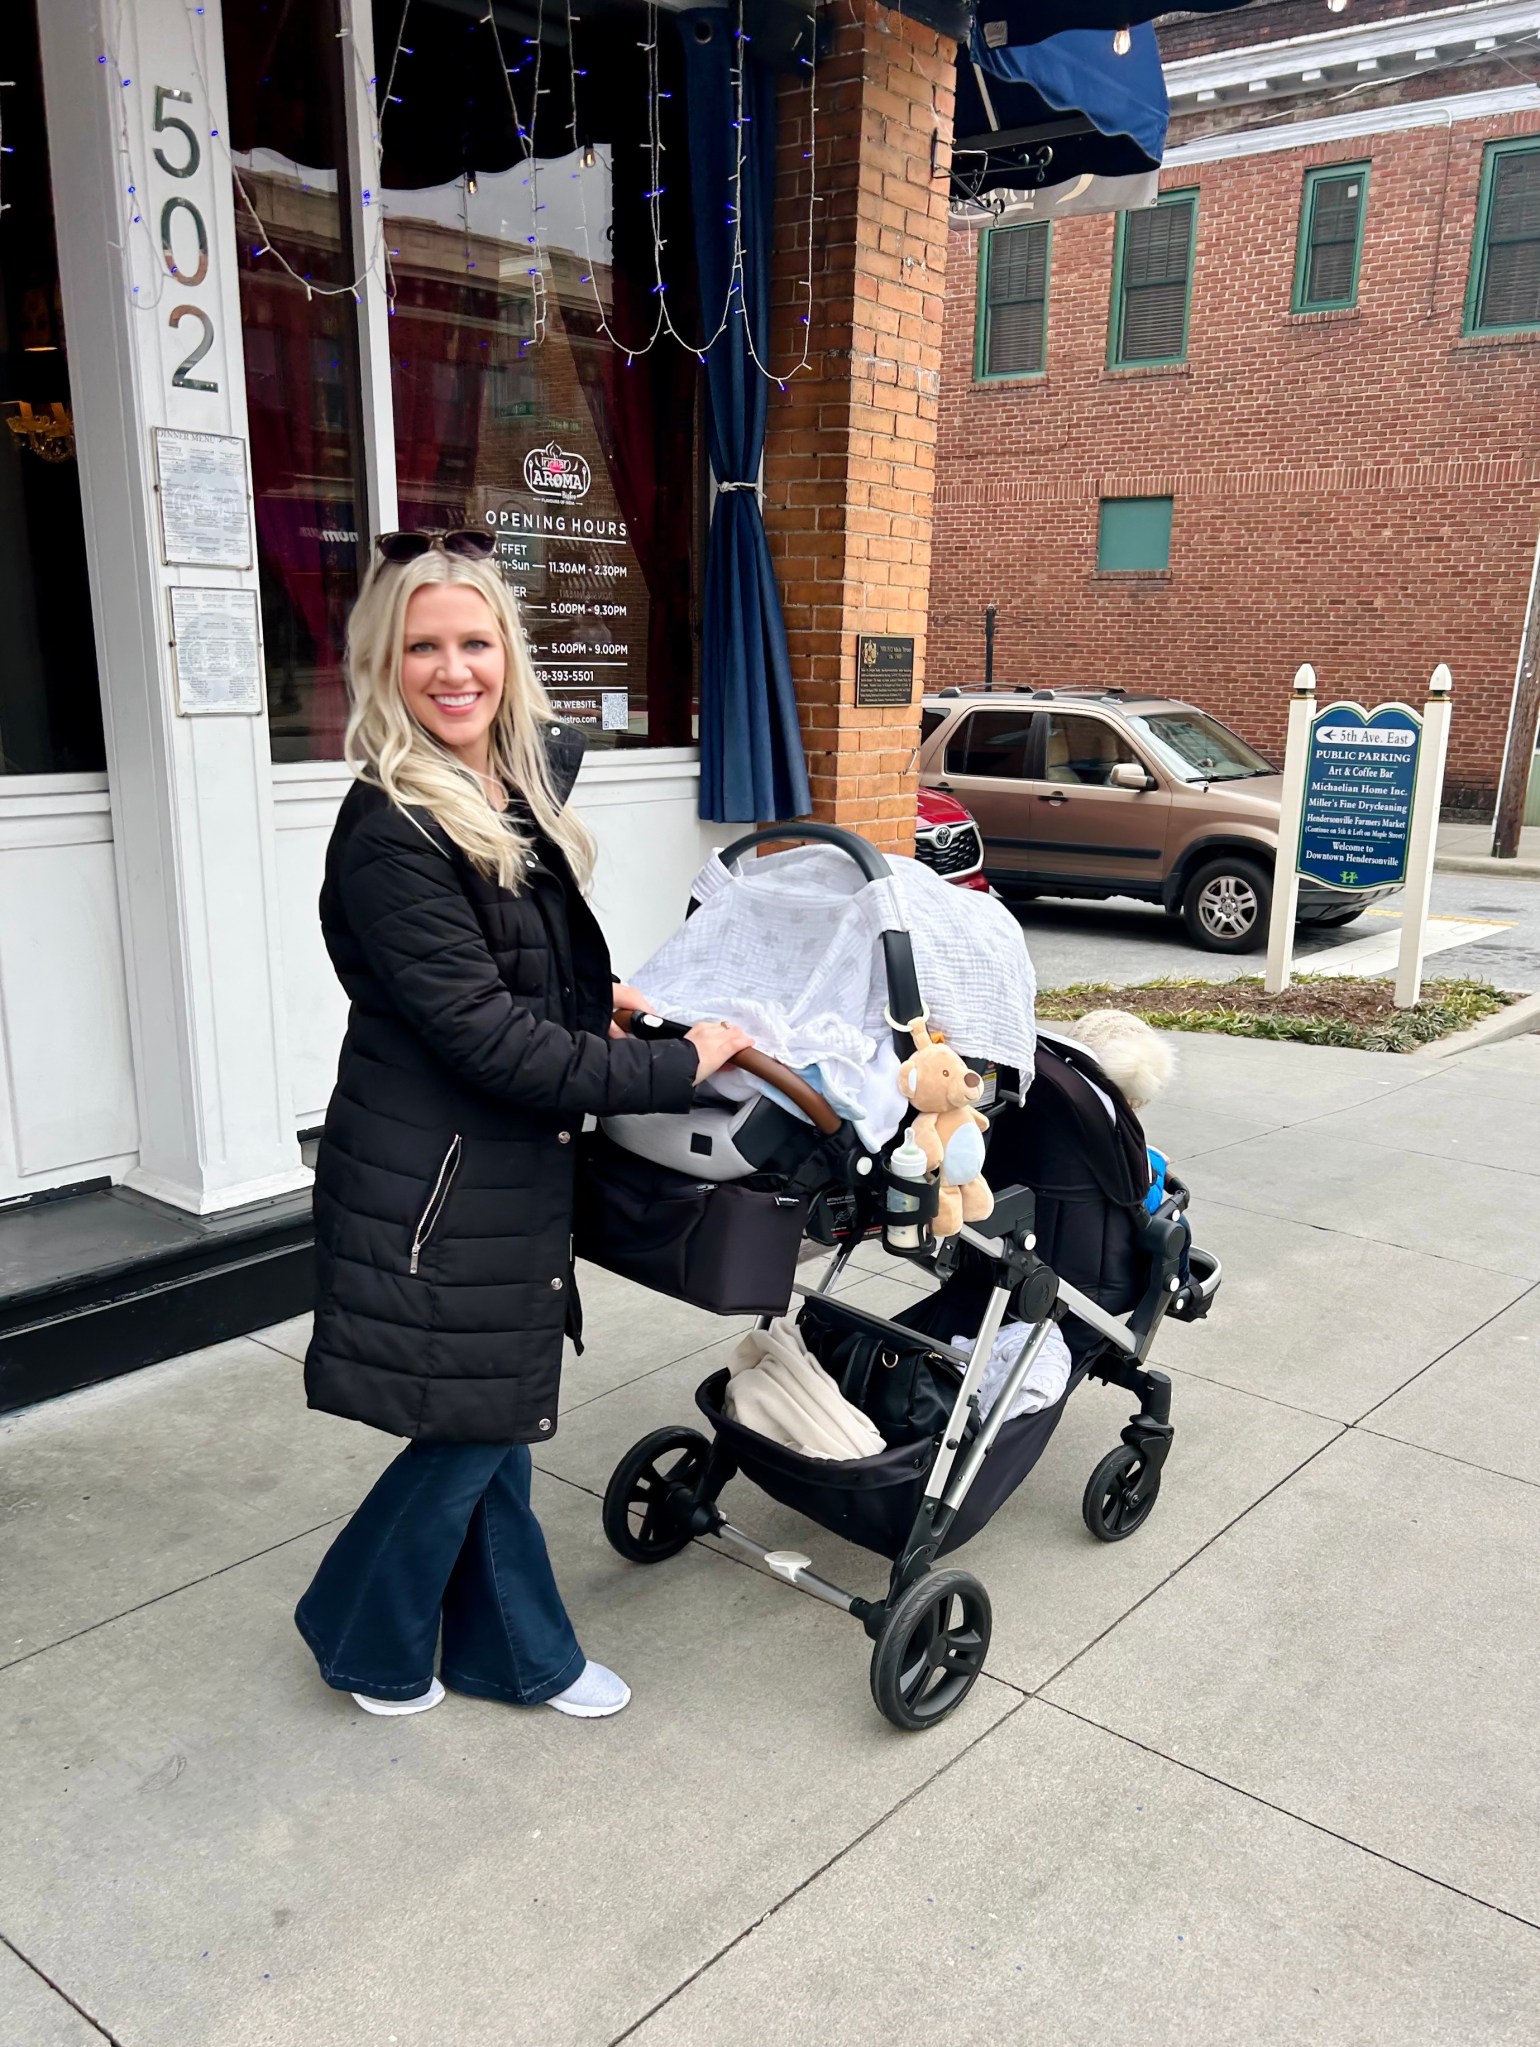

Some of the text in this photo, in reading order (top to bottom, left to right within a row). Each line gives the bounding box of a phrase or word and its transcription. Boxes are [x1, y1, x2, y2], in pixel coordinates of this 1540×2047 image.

[532, 470, 583, 490] AROMA
[485, 510, 627, 537] OPENING HOURS
[548, 561, 586, 575] 11.30AM
[594, 565, 627, 578] 2.30PM
[550, 602, 586, 614] 5.00PM
[594, 604, 627, 616] 9.30PM
[551, 643, 586, 654] 5.00PM
[594, 644, 628, 655] 9.00PM
[536, 671, 594, 681] 28-393-5501
[563, 700, 597, 708] WEBSITE
[1340, 729, 1409, 744] 5th Ave. East
[1315, 750, 1411, 763] PUBLIC PARKING
[1328, 765, 1394, 778] Art & Coffee Bar
[1311, 782, 1408, 796] Michaelian Home Inc.
[1308, 798, 1408, 814] Miller's Fine Drycleaning
[1307, 813, 1406, 828] Hendersonville Farmers Market
[1353, 828, 1363, 837] Left
[1371, 830, 1388, 839] Maple
[1332, 841, 1374, 853] Welcome to
[1306, 850, 1399, 867] Downtown Hendersonville
